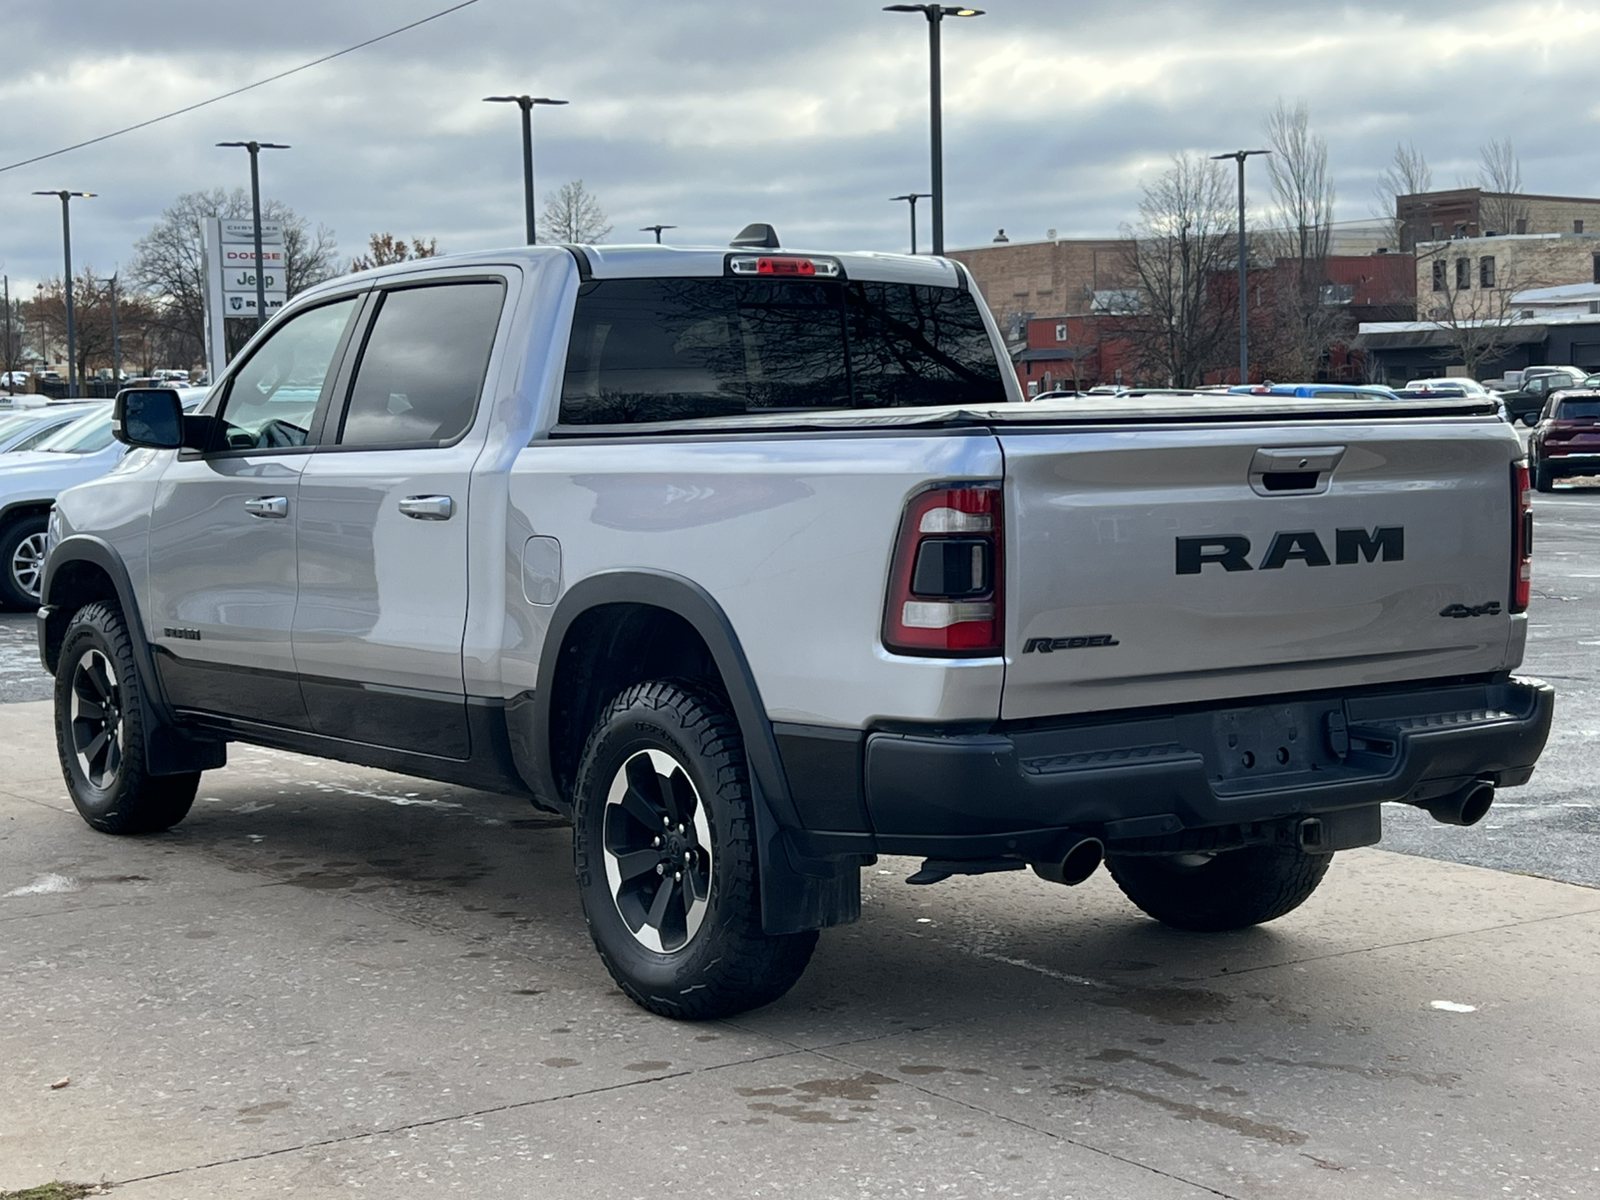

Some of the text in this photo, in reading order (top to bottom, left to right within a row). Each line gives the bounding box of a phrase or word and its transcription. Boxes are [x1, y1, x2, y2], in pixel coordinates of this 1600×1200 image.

[227, 252, 281, 260] DODGE
[237, 271, 274, 289] Jep
[1175, 524, 1404, 575] RAM
[1439, 601, 1502, 618] 4x4
[1022, 633, 1120, 654] REBEL
